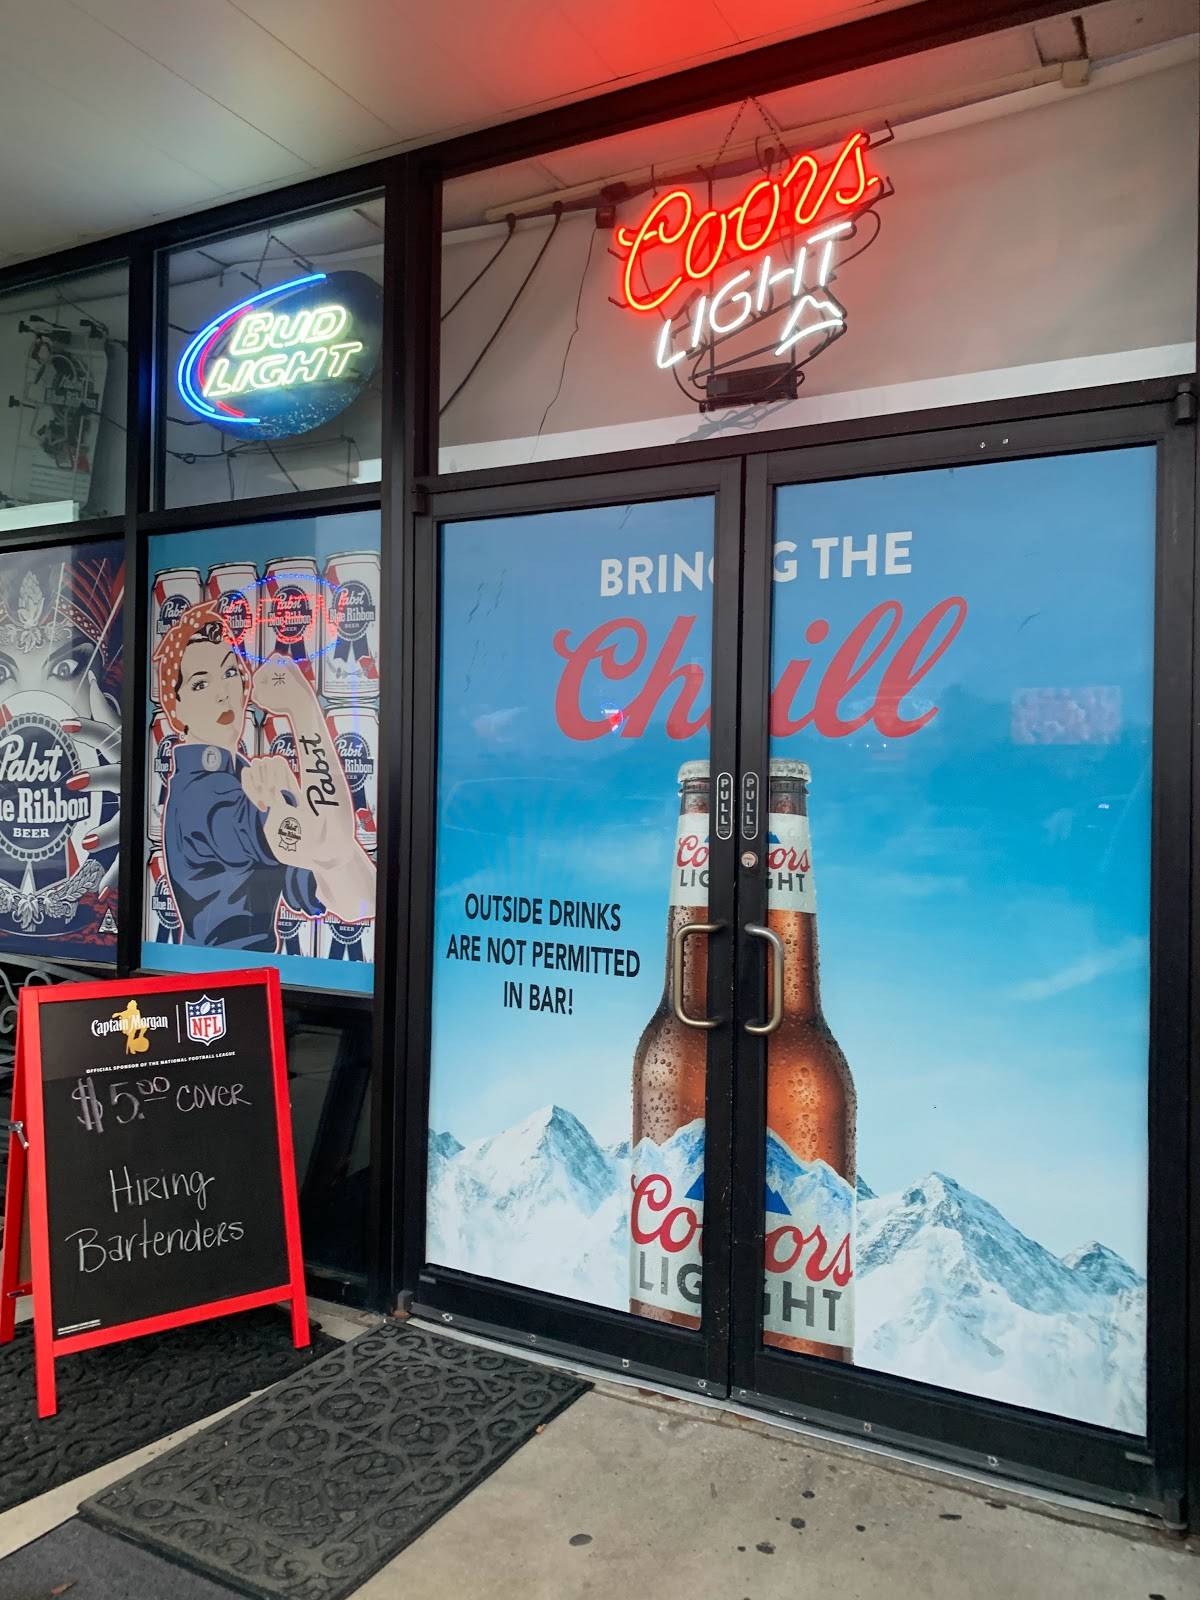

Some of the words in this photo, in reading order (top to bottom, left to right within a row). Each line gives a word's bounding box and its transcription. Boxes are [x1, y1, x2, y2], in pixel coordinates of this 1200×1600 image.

[617, 132, 880, 311] Coors
[656, 221, 852, 368] LIGHT
[229, 305, 347, 356] BUD
[203, 341, 363, 398] LIGHT
[811, 531, 913, 580] THE
[337, 588, 366, 605] Pabst
[346, 607, 375, 622] Ribbon
[552, 596, 968, 741] Chill
[0, 734, 63, 783] Pabst
[335, 739, 363, 757] Pabst
[345, 758, 373, 773] Ribbon
[299, 732, 340, 817] Pabst
[17, 787, 90, 825] Ribbon
[720, 778, 729, 825] PULL
[745, 778, 754, 825] PULL
[12, 827, 50, 839] BEER
[465, 893, 543, 925] OUTSIDE
[549, 899, 621, 932] DRINKS
[446, 933, 481, 962] ARE
[487, 937, 527, 966] NOT
[532, 941, 641, 978] PERMITTED
[504, 980, 523, 1009] IN
[529, 983, 573, 1016] BAR!
[91, 1016, 129, 1038] Captain
[130, 1013, 169, 1031] Morgan
[191, 1015, 222, 1038] NFL
[86, 1066, 112, 1074] OFFICIAL
[113, 1063, 139, 1071] SPONSOR
[160, 1057, 187, 1065] NATIONAL
[188, 1053, 215, 1061] FOOTBALL
